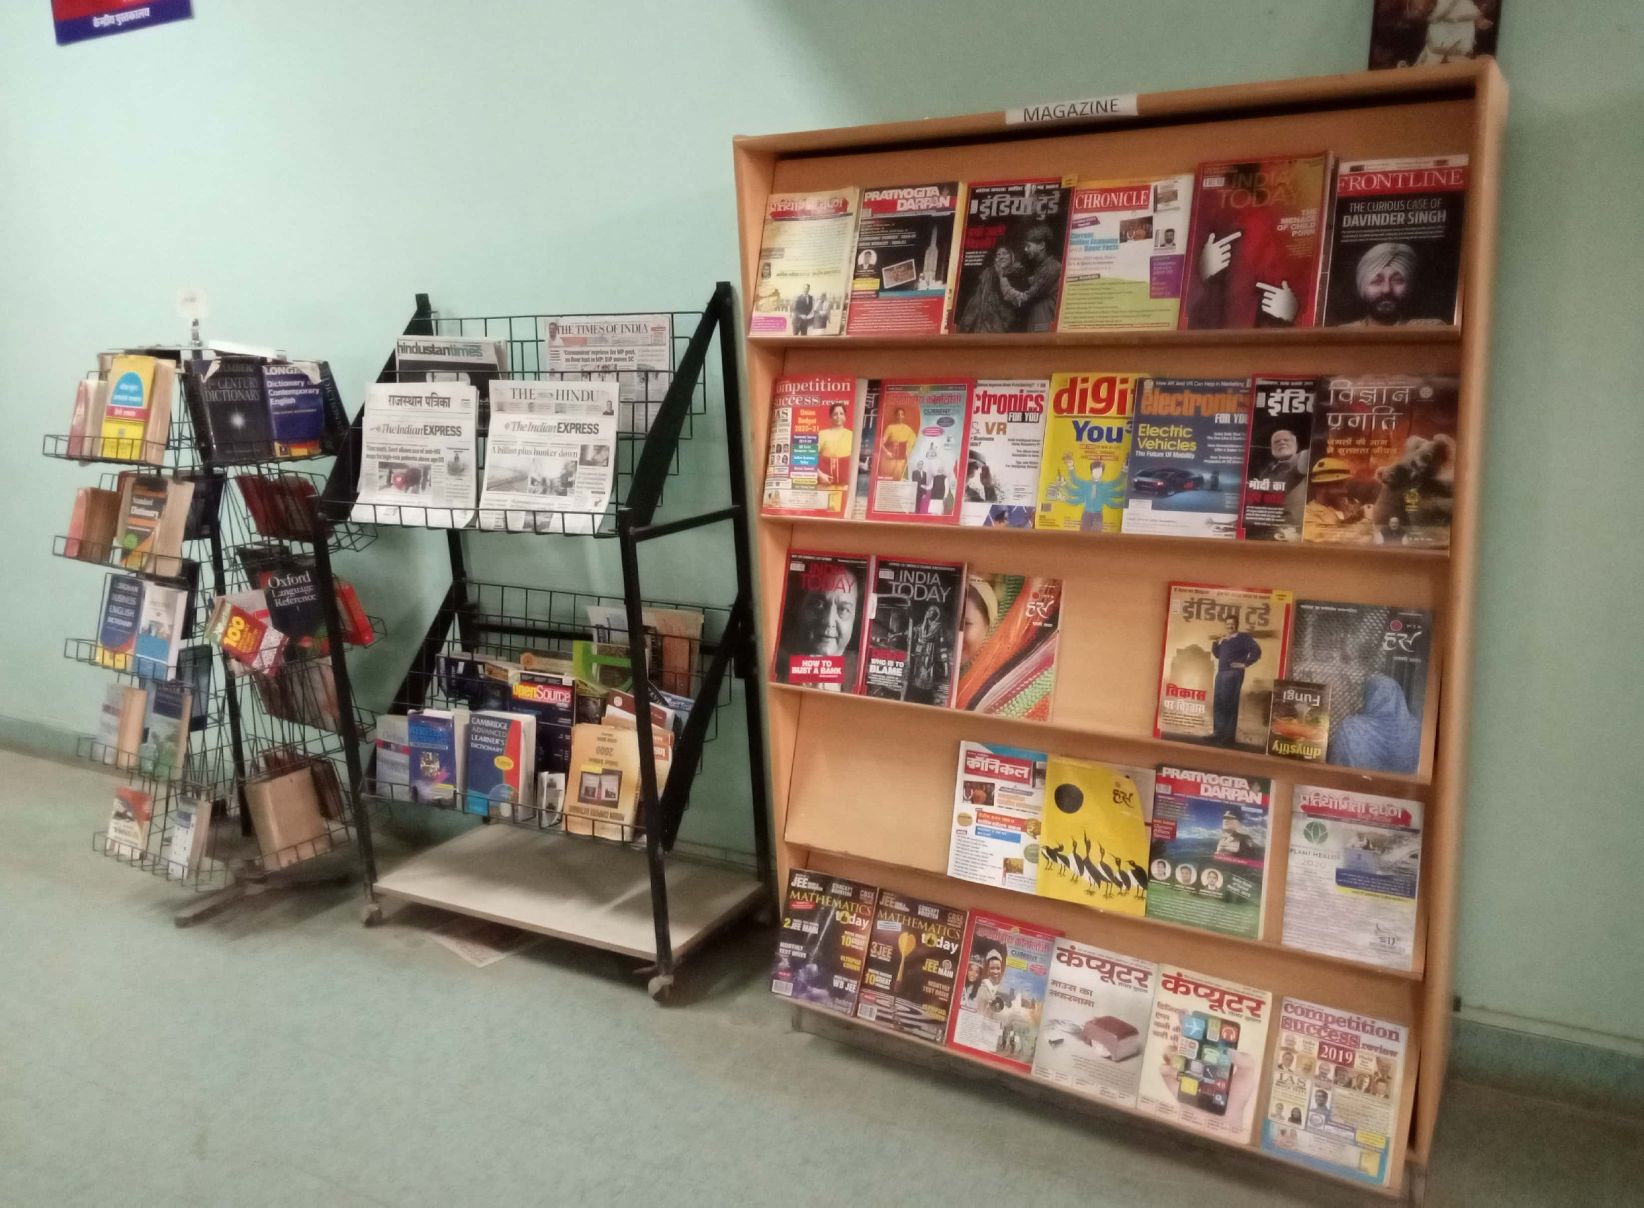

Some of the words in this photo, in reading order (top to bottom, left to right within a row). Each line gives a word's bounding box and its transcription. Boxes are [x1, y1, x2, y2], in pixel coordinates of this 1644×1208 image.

[1023, 97, 1121, 122] MAGAZINE
[1337, 168, 1465, 193] FRONTLINE
[864, 186, 940, 202] PRATIYOGITA
[1075, 190, 1149, 209] CHRONICLE
[896, 196, 951, 212] DARPAN
[1349, 201, 1366, 213] THE
[1366, 199, 1405, 212] CURIOUS
[1406, 198, 1428, 210] CASE
[1430, 197, 1443, 209] OF
[1342, 211, 1405, 228] DAVINDER
[1407, 208, 1447, 225] SINGH
[1276, 223, 1289, 233] OF
[557, 325, 573, 335] THE
[576, 324, 604, 335] TIMES
[606, 324, 620, 334] OF
[621, 322, 649, 334] INDIA
[265, 366, 296, 376] LONG
[266, 380, 305, 388] Dictionary
[777, 378, 851, 395] ompetition
[268, 388, 320, 397] Contemporary
[511, 387, 536, 401] THE
[555, 388, 595, 402] HINDU
[1328, 379, 1416, 405] विज्ञान
[270, 398, 296, 407] English
[388, 394, 423, 407] राजस्थान
[425, 391, 452, 409] पत्रिका
[973, 389, 1045, 415] ctronics
[1008, 411, 1022, 422] FOR
[1024, 411, 1040, 422] YOU
[1215, 412, 1231, 424] FOR
[1326, 404, 1404, 431] प्रगति
[381, 423, 396, 435] The
[396, 424, 424, 436] Indian
[423, 424, 462, 437] EXPRESS
[511, 421, 528, 432] The
[527, 421, 557, 434] Indian
[557, 422, 600, 435] EXPRESS
[985, 421, 1008, 436] VR
[1072, 420, 1124, 443] You
[1138, 423, 1193, 438] Electric
[1137, 437, 1197, 452] Vehicles
[518, 447, 532, 458] plus
[559, 449, 578, 459] down
[1146, 450, 1165, 458] Future
[267, 570, 312, 588] Oxford
[899, 569, 942, 586] INDIA
[271, 585, 315, 598] Language
[888, 580, 952, 603] TODAY
[274, 594, 317, 607] Reference
[108, 604, 136, 617] ENGLISH
[223, 615, 246, 648] 100
[791, 666, 811, 675] BUST
[813, 667, 819, 675] A
[820, 665, 842, 675] BANK
[802, 659, 820, 668] HOW
[821, 659, 833, 668] TO
[868, 664, 903, 677] BLAME
[871, 658, 886, 666] WHO
[894, 660, 905, 668] TO
[1283, 688, 1321, 707] Fungi
[471, 717, 508, 730] CAMBRIDGE
[471, 726, 507, 738] ADVANCED
[470, 735, 505, 746] LEARNER'S
[470, 742, 504, 753] DICTIONARY
[1161, 767, 1250, 790] PRATIYOGITA
[1200, 783, 1263, 805] DARPAN
[791, 876, 809, 889] JEE
[790, 890, 872, 916] MATHEMATICS
[783, 917, 792, 929] 2
[877, 909, 962, 940] MATHEMATICS
[842, 935, 852, 947] 10
[871, 941, 878, 952] 3
[922, 959, 939, 973] JEE
[938, 968, 954, 979] MAIN
[1056, 945, 1153, 988] कंप्यूटर
[832, 979, 844, 989] WB
[845, 982, 857, 993] JEE
[865, 972, 875, 985] 10
[1079, 985, 1094, 997] का
[1161, 971, 1266, 1019] कंप्यूटर
[1283, 1002, 1400, 1043] competition
[1282, 1017, 1359, 1047] success
[1361, 1041, 1399, 1059] review
[1320, 1044, 1355, 1064] 2019
